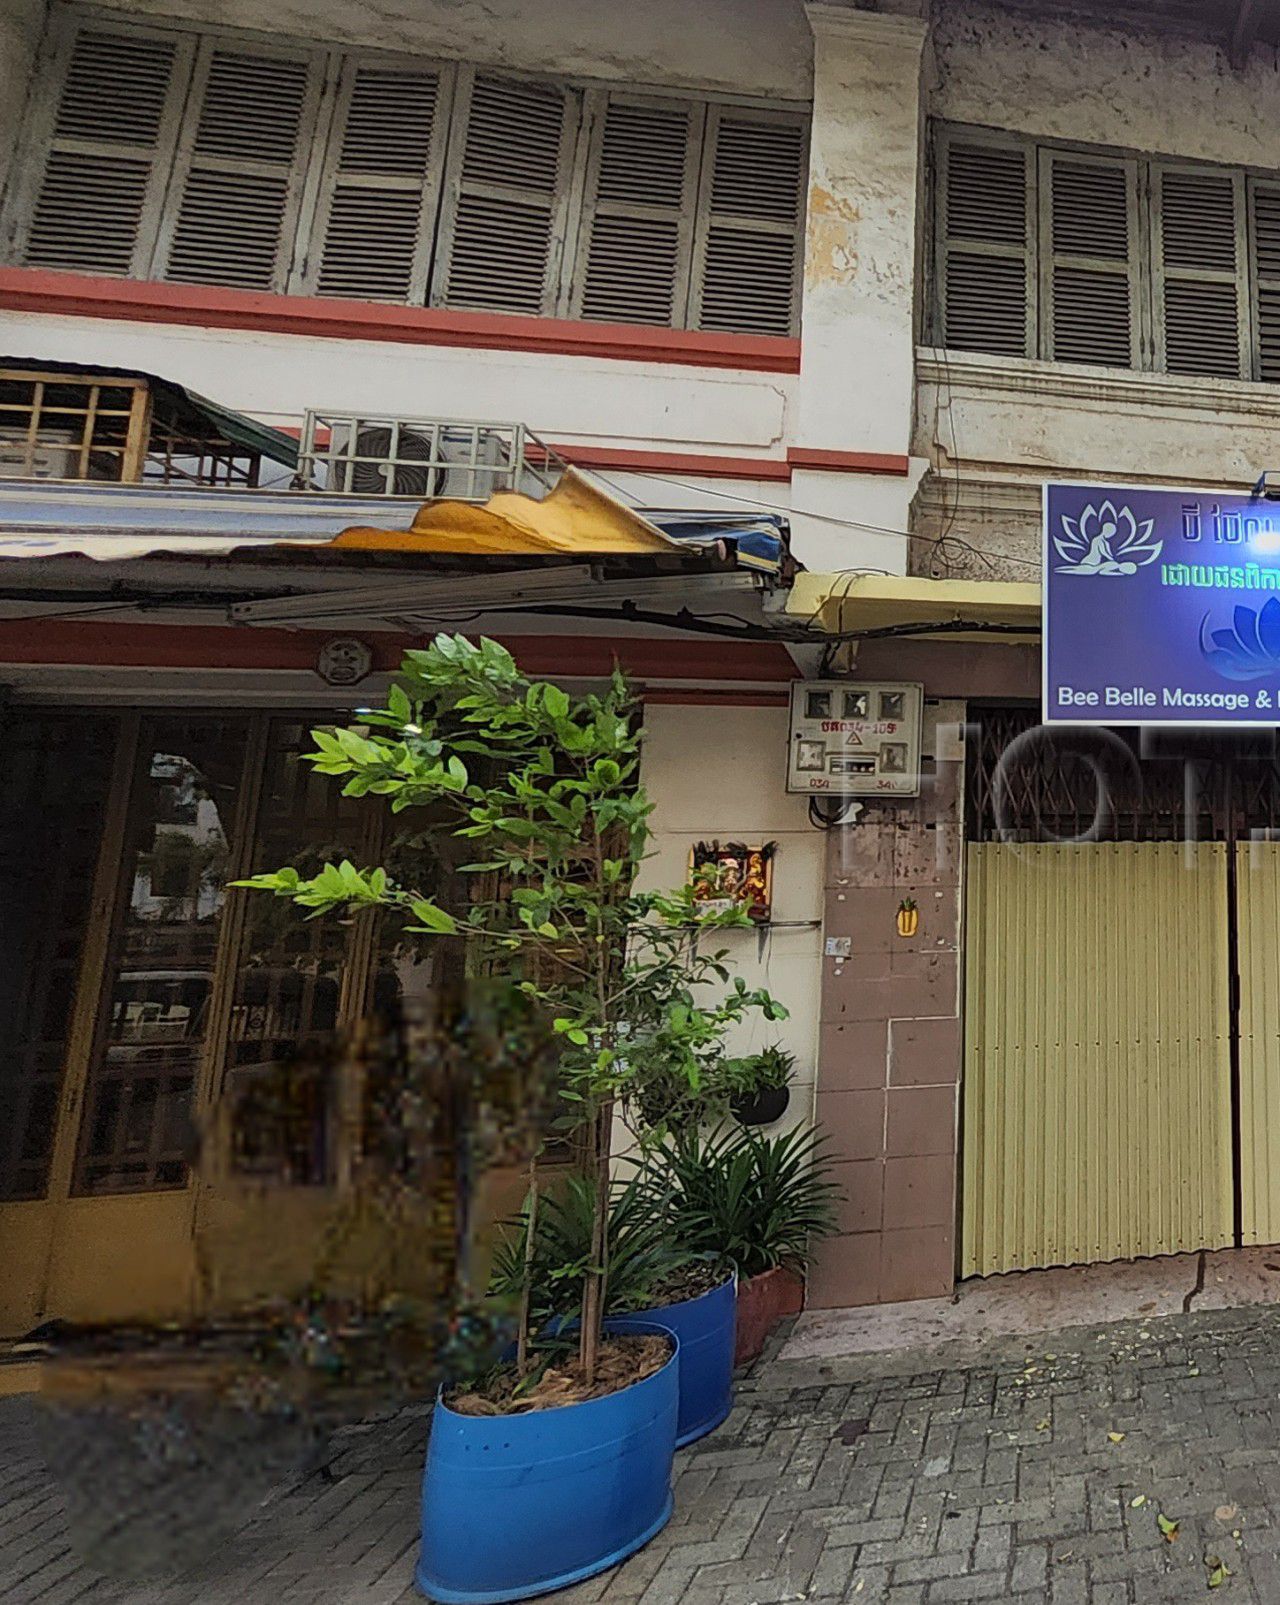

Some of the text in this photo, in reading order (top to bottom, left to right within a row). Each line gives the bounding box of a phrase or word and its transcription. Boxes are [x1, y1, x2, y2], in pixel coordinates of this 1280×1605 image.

[1058, 686, 1099, 706] Bee
[1105, 687, 1156, 706] Belle
[1162, 688, 1249, 711] Massage
[1255, 690, 1272, 708] &
